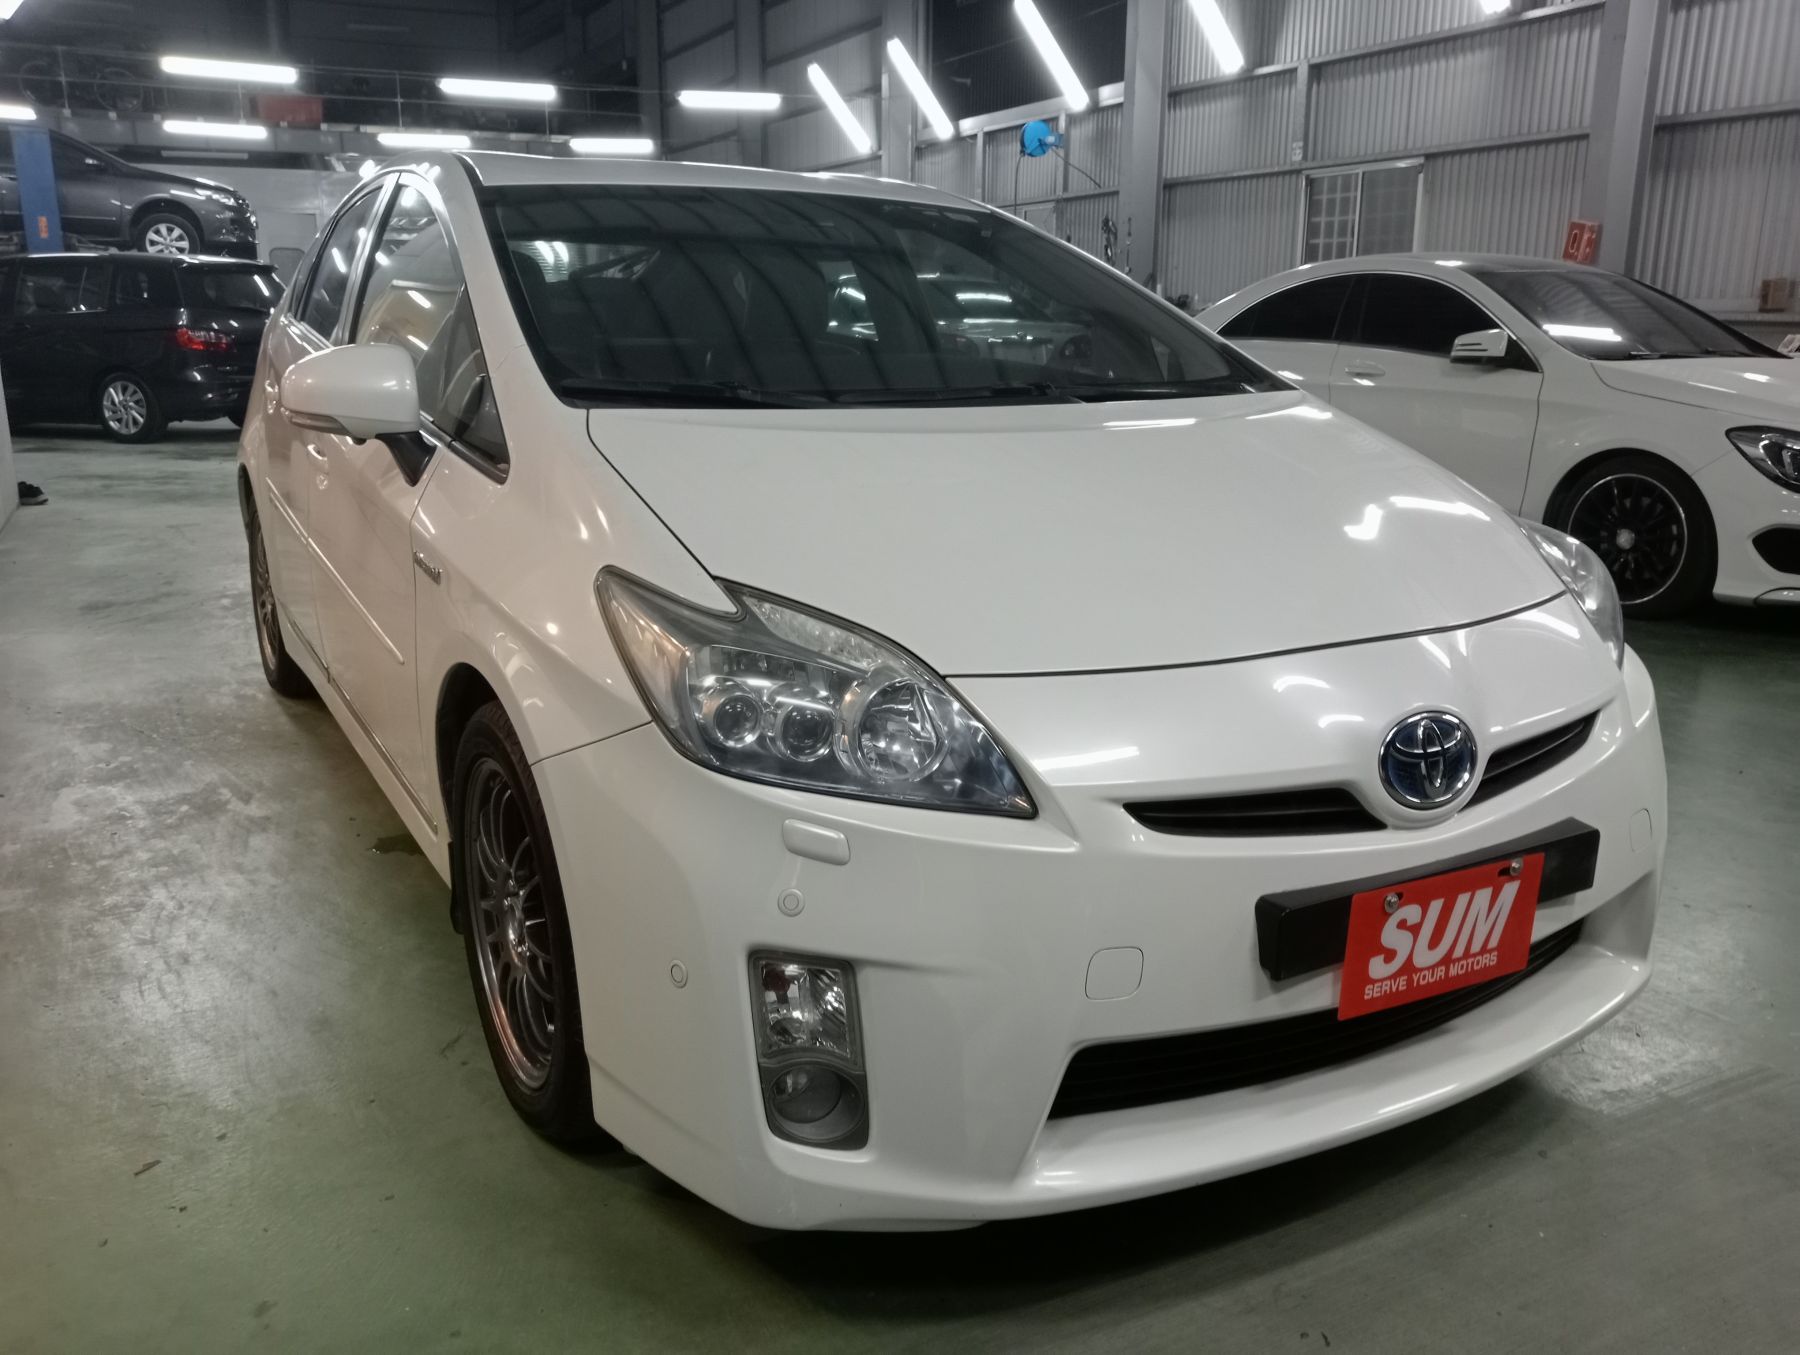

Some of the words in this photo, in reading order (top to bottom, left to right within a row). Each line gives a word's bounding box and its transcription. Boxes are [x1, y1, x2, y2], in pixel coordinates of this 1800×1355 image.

[1368, 880, 1521, 980] SUM
[1364, 976, 1407, 1000] SERVE
[1412, 967, 1445, 987] YOUR
[1449, 951, 1498, 977] MOTORS
